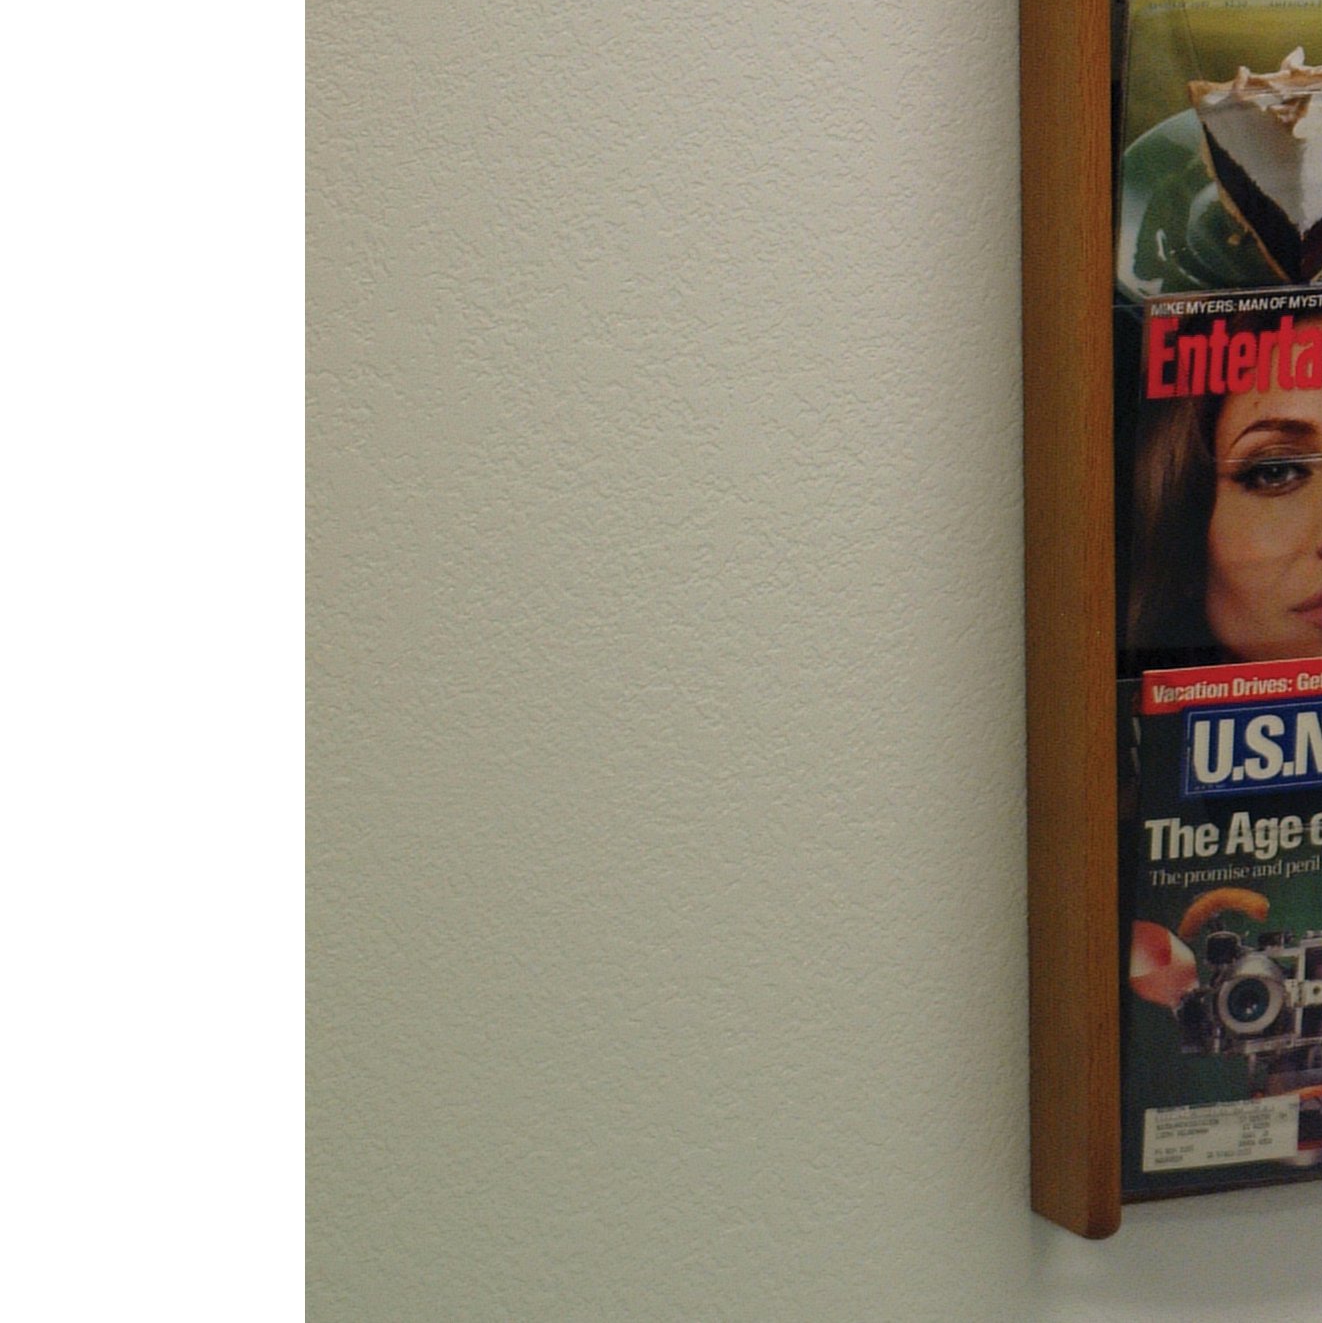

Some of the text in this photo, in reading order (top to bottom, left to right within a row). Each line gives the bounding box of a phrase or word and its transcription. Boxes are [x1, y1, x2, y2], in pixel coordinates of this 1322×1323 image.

[1151, 300, 1185, 316] MIKE
[1238, 297, 1269, 312] MAN
[1270, 296, 1288, 310] OF
[1152, 680, 1229, 704] Vacation
[1232, 677, 1293, 697] Drives:
[1145, 817, 1220, 861] The
[1225, 811, 1303, 860] Age
[1150, 869, 1182, 887] The
[1184, 863, 1250, 888] promise
[1252, 859, 1283, 878] and
[1286, 854, 1321, 878] peril
